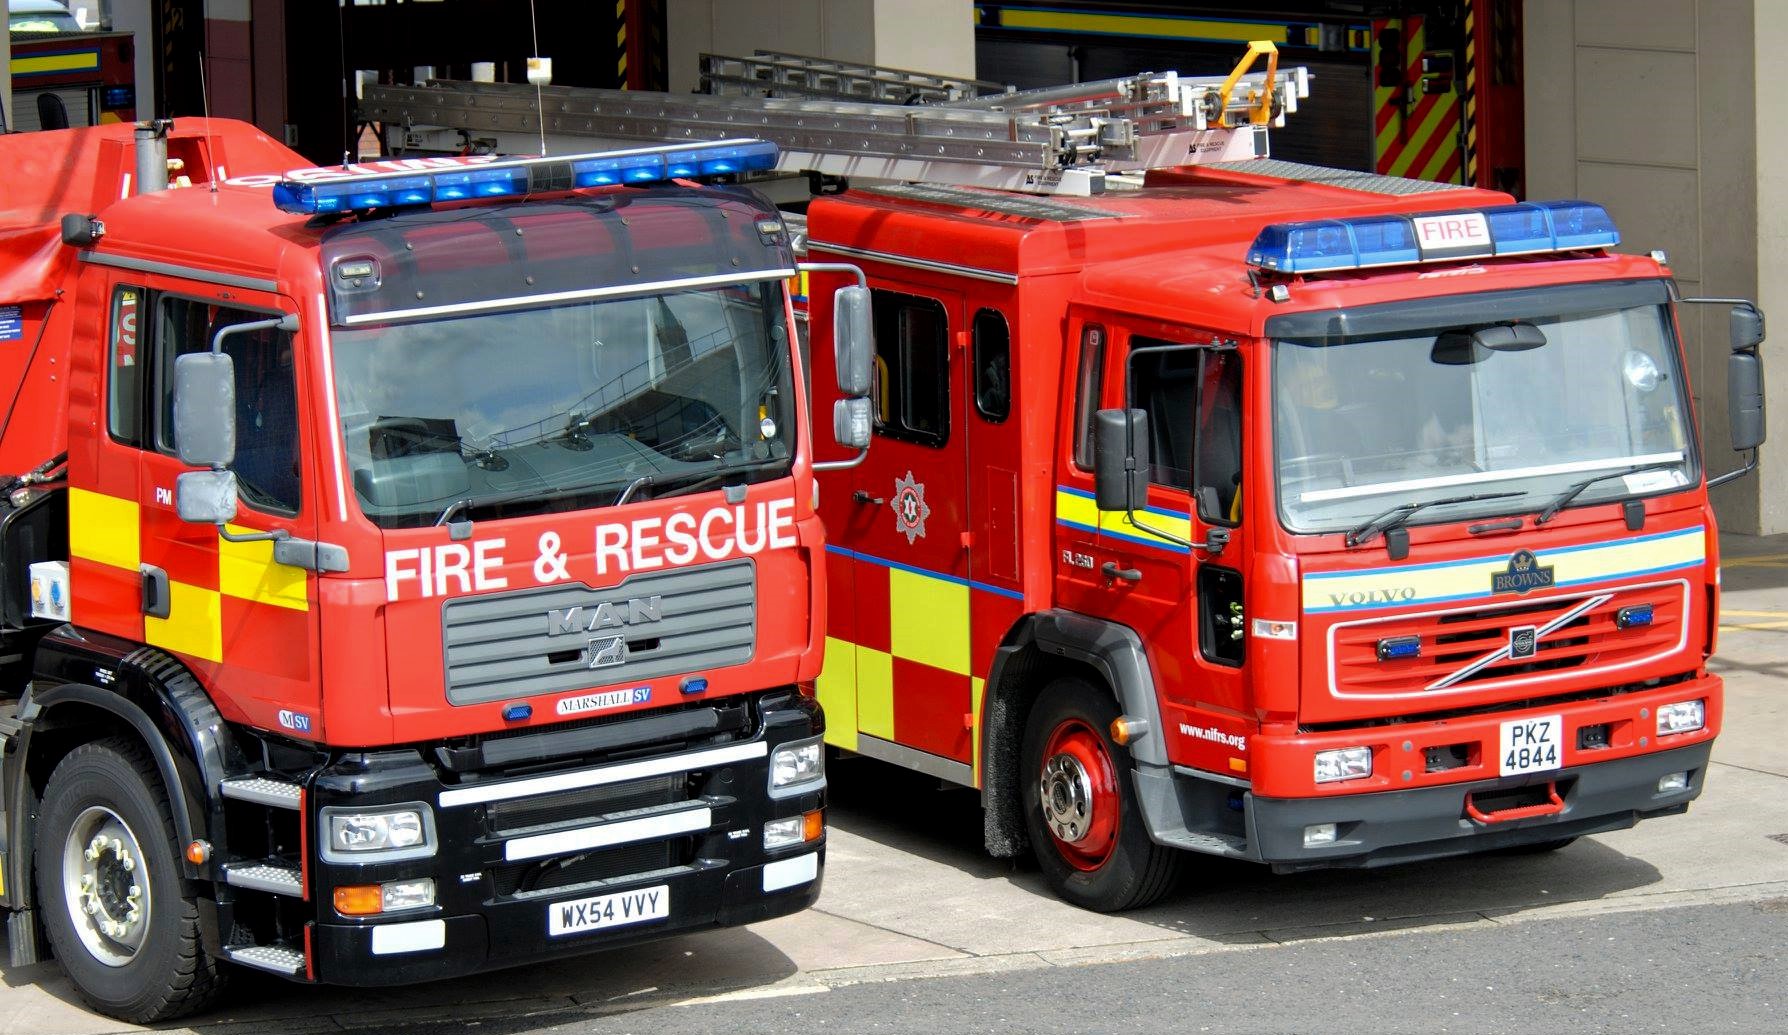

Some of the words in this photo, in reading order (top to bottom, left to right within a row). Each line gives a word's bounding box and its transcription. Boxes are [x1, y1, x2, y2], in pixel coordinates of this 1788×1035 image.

[1422, 219, 1482, 241] FIRE
[156, 486, 172, 506] PM
[385, 537, 509, 602] FIRE
[533, 530, 572, 584] &
[595, 497, 797, 575] RESCUE
[1496, 569, 1551, 590] BROWNS
[1328, 586, 1416, 606] VOLVO
[547, 595, 662, 636] MAN
[561, 691, 630, 713] MARSHALL
[634, 687, 651, 703] SV
[294, 714, 309, 730] SV
[1512, 721, 1551, 747] PKZ
[1179, 722, 1246, 751] www.nifrs.org
[1505, 743, 1557, 770] 4844
[561, 898, 615, 929] WX54
[622, 890, 659, 918] VVY
